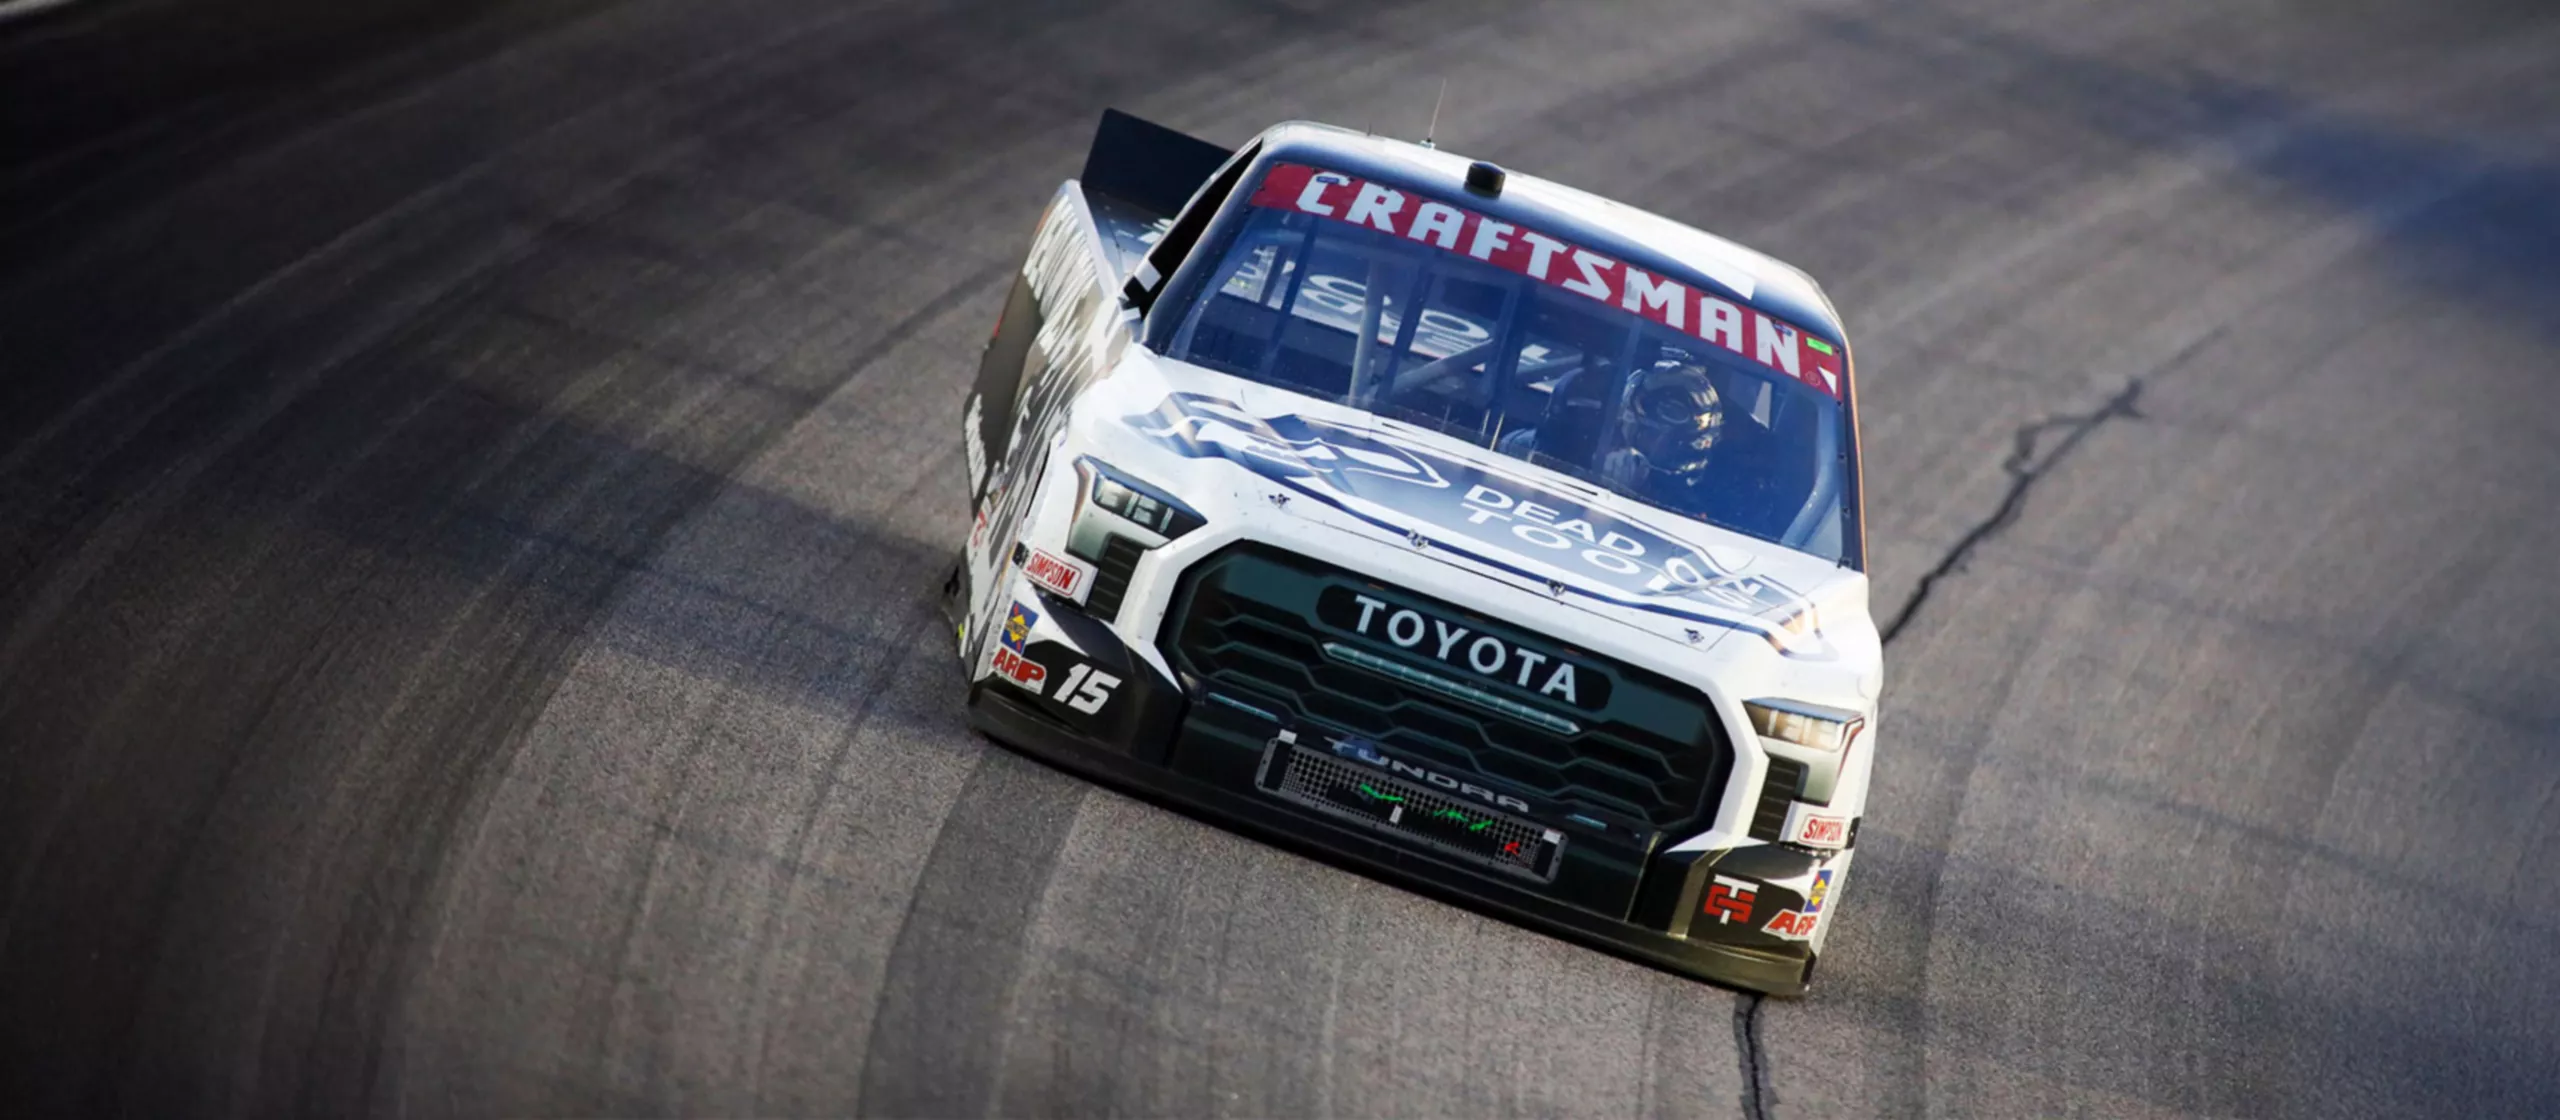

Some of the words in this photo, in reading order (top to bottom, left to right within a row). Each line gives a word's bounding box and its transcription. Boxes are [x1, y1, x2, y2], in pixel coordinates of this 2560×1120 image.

[1296, 171, 1800, 379] CRAFTSMAN
[1464, 484, 1647, 557] DEAD
[1026, 552, 1077, 590] SIMPSON
[992, 646, 1046, 685] ARP
[1355, 594, 1577, 705] TOYOTA
[1052, 662, 1122, 716] 15
[1324, 736, 1529, 814] TUNDRA
